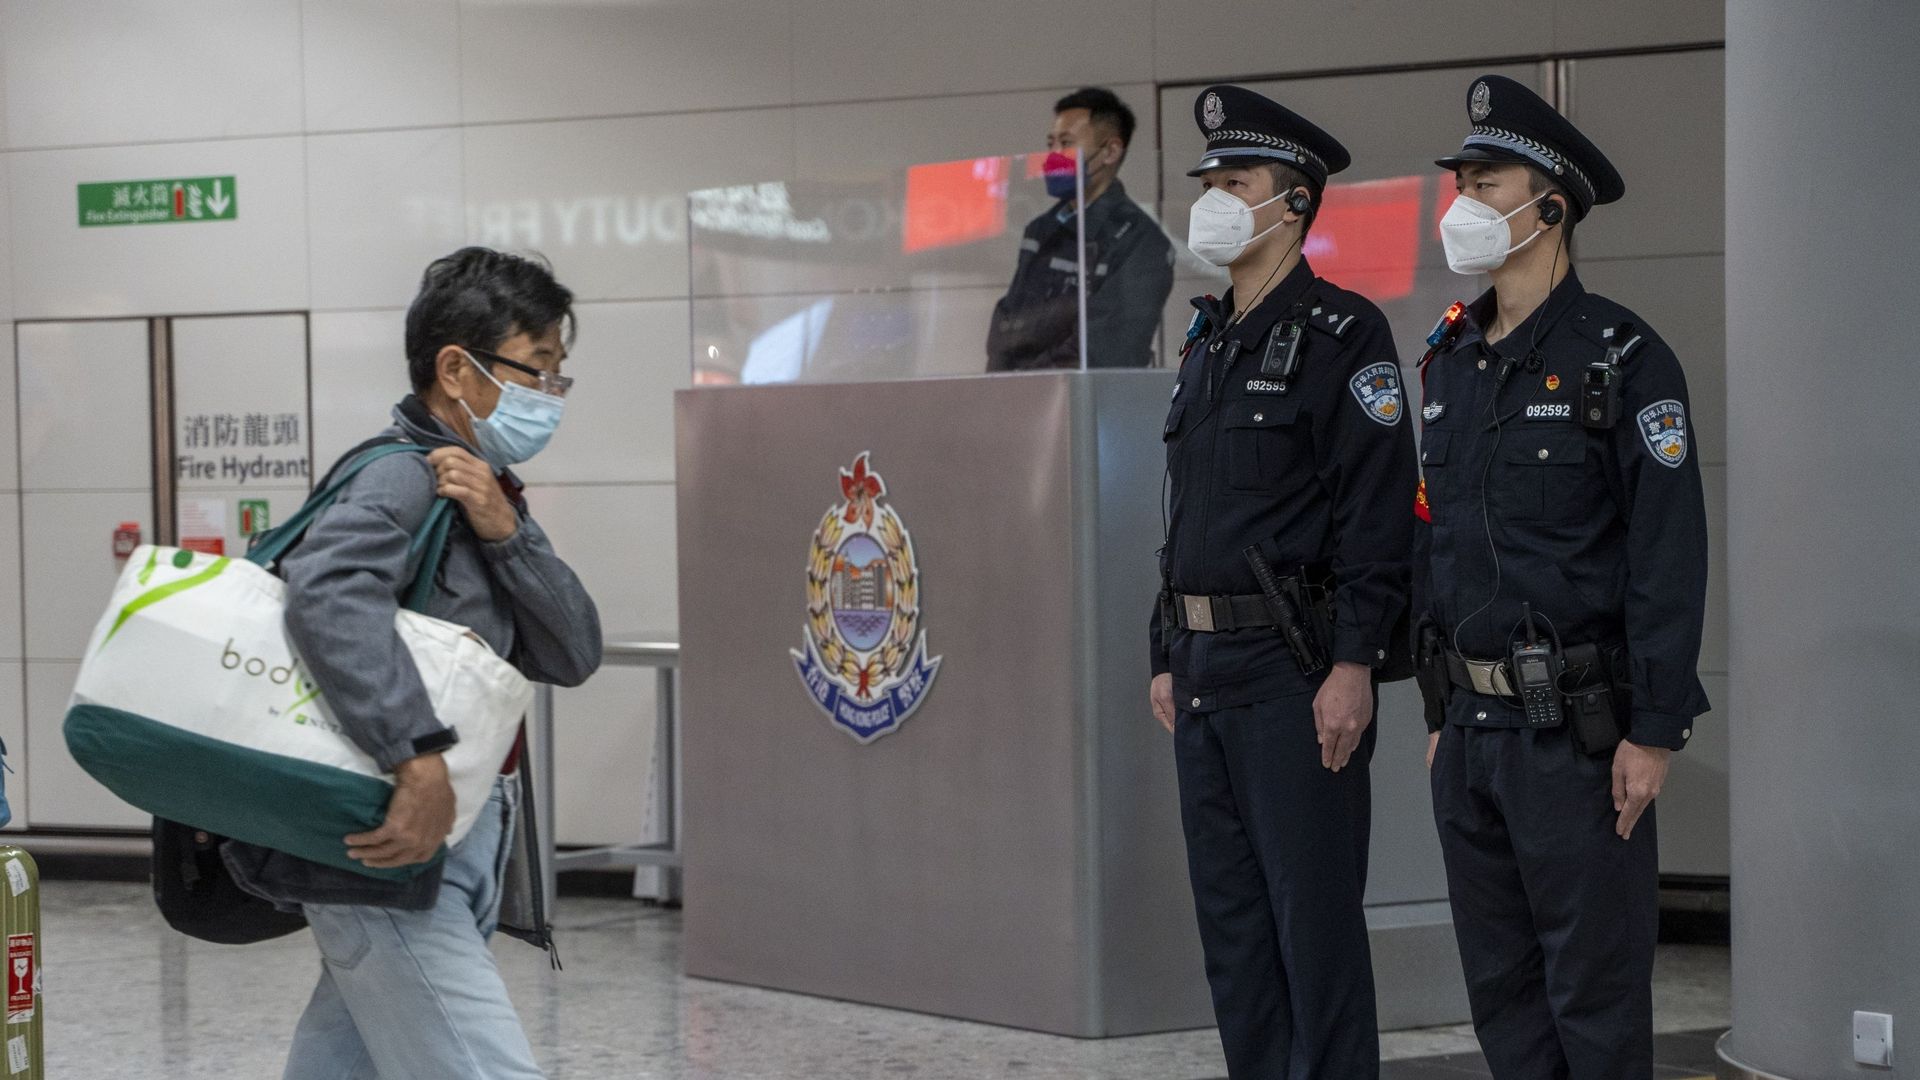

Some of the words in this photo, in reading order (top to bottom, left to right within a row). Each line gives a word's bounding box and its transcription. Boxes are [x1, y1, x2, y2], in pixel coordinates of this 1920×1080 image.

[1246, 380, 1287, 391] 092595
[1526, 404, 1571, 417] 092592
[184, 413, 299, 448] 消防龍頭
[177, 455, 216, 479] Fire
[221, 454, 309, 484] Hydrant
